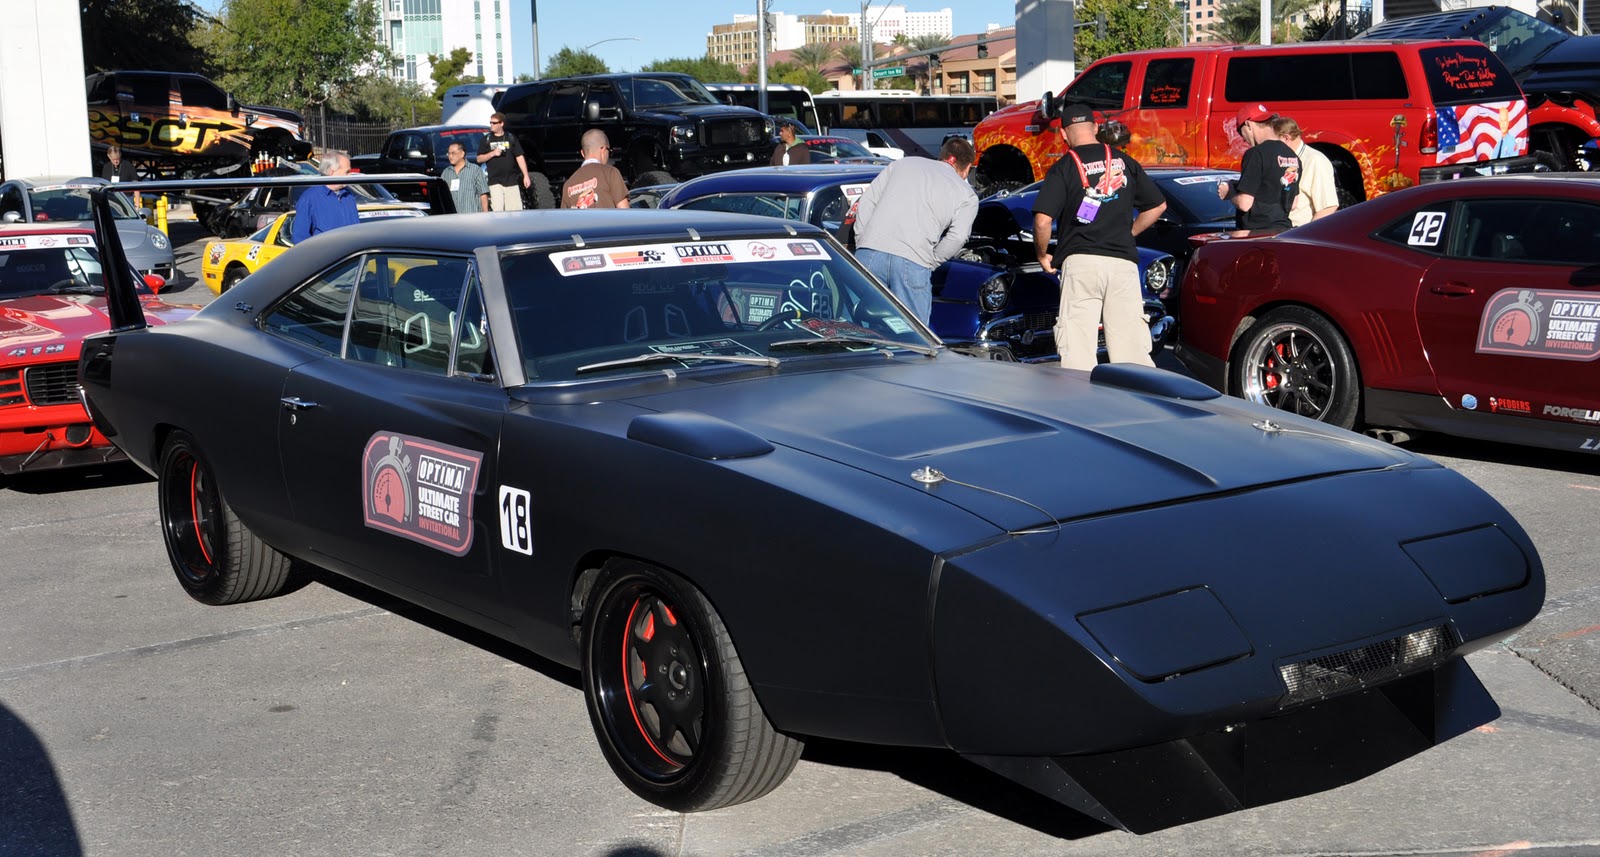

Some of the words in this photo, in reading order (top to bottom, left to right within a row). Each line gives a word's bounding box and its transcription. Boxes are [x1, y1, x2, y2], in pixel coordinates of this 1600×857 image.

[115, 117, 226, 151] SCT
[1411, 214, 1443, 243] 42
[678, 244, 730, 257] OPTIMA
[750, 296, 774, 306] OPTIMA
[749, 307, 773, 317] ULTIMATE
[1553, 302, 1600, 318] OPTIMA
[1548, 319, 1598, 333] ULTIMATE
[1546, 330, 1577, 341] STREET
[1577, 332, 1596, 342] CAR
[1544, 340, 1594, 350] INVITATIONAL
[1498, 398, 1531, 411] PEDDERS
[1543, 405, 1600, 421] FORGELI
[420, 459, 463, 490] OPTIMA
[418, 486, 460, 513] ULTIMATE
[418, 503, 445, 522] STREET
[444, 509, 460, 527] CAR
[502, 491, 529, 551] 18
[418, 516, 460, 541] INVITATIONAL
